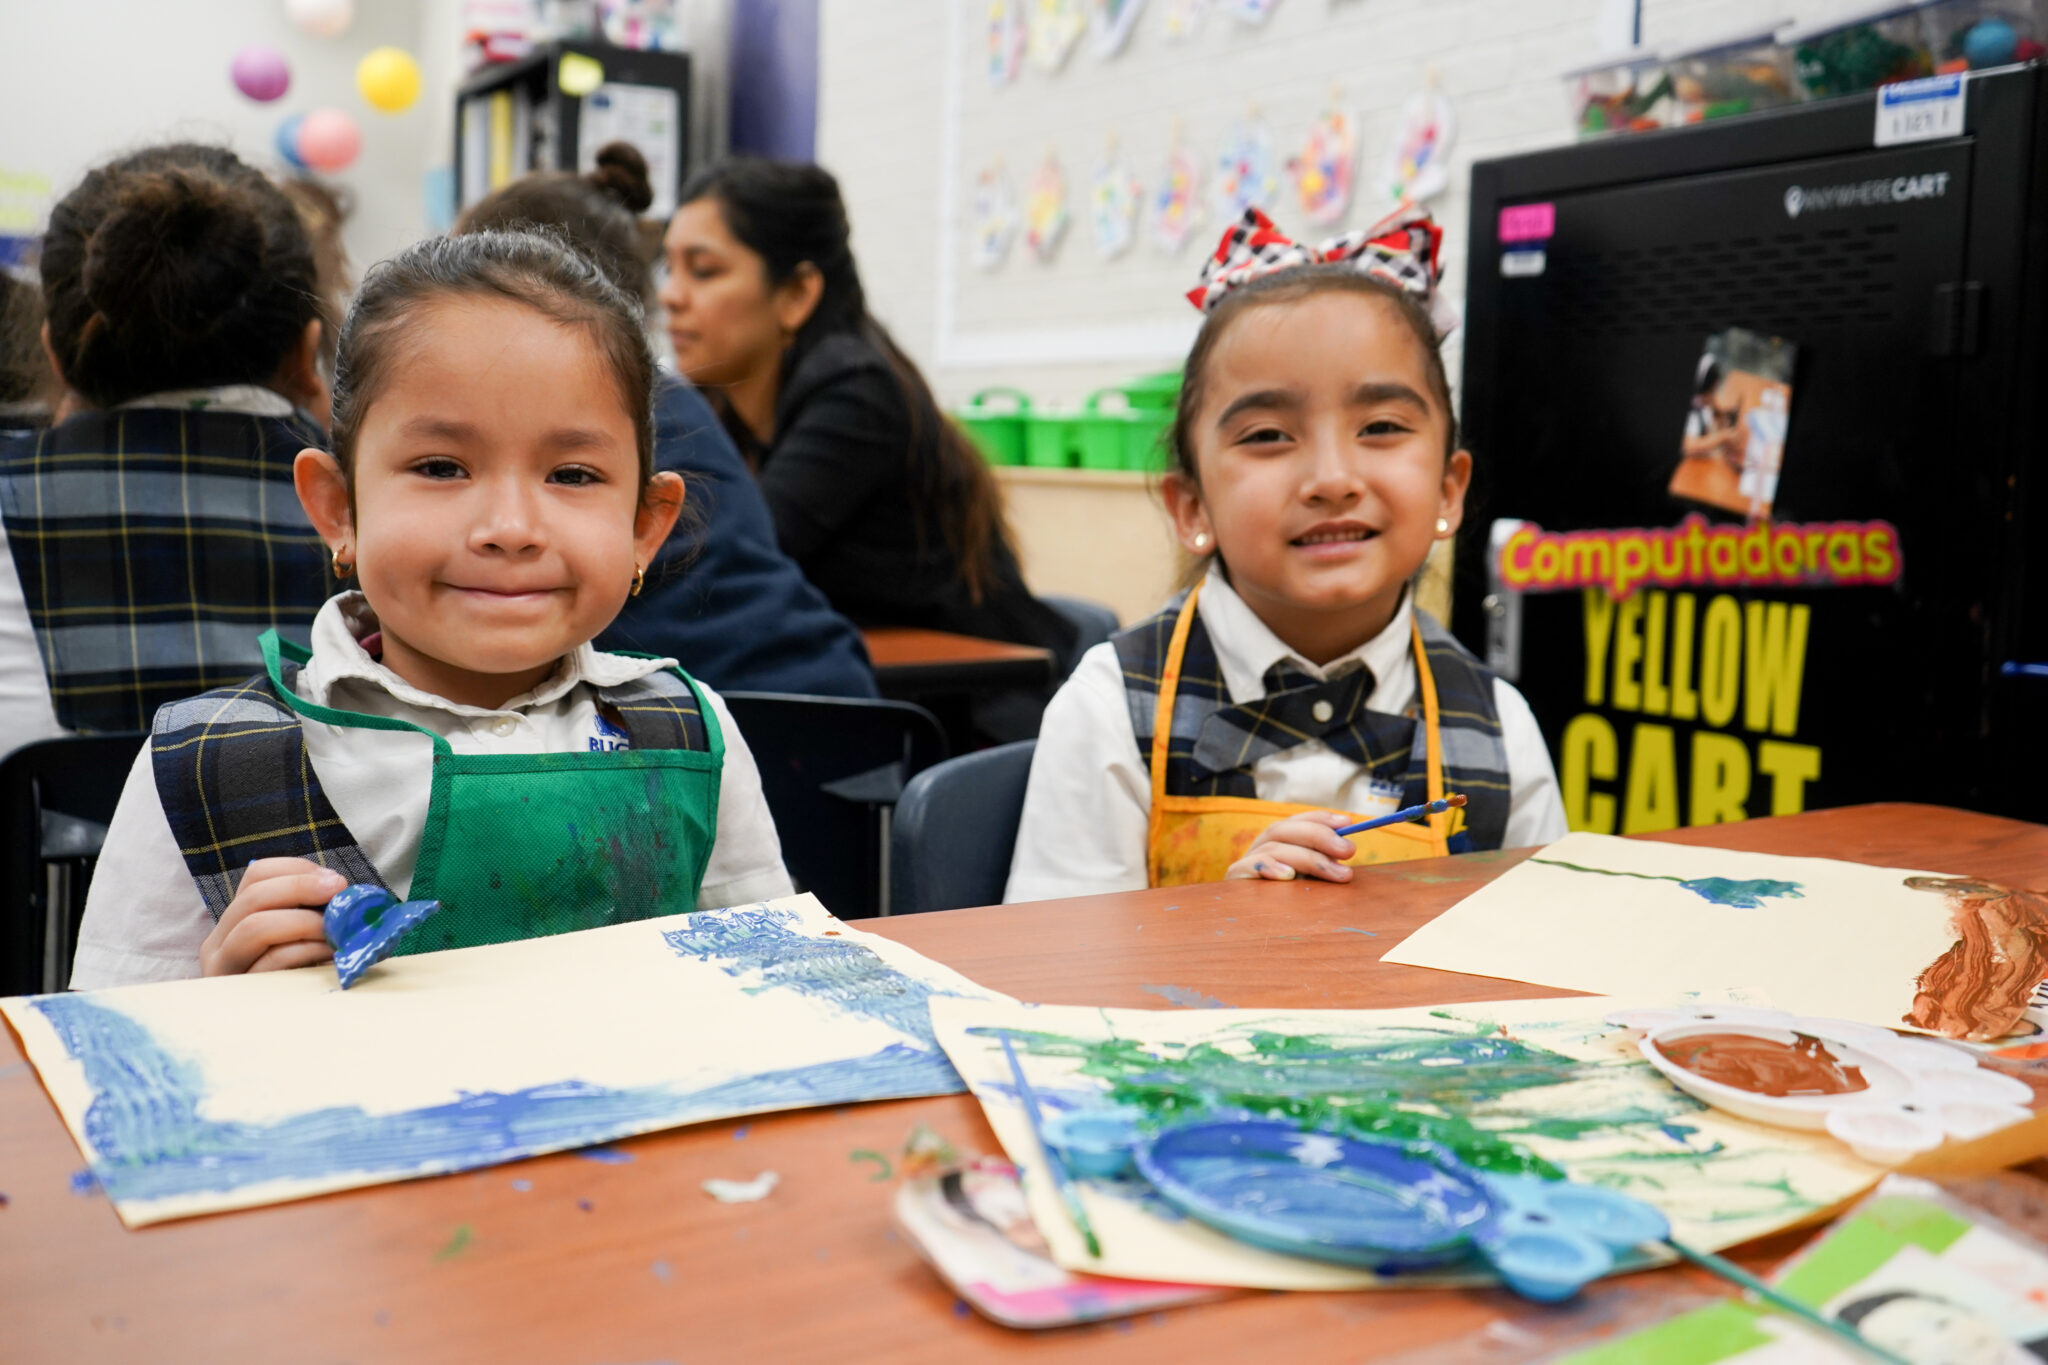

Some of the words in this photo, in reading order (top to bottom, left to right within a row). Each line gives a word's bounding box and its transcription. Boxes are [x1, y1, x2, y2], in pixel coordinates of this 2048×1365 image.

[1503, 521, 1895, 593] Computadoras
[1583, 584, 1811, 737] YELLOW
[1563, 712, 1822, 835] CART
